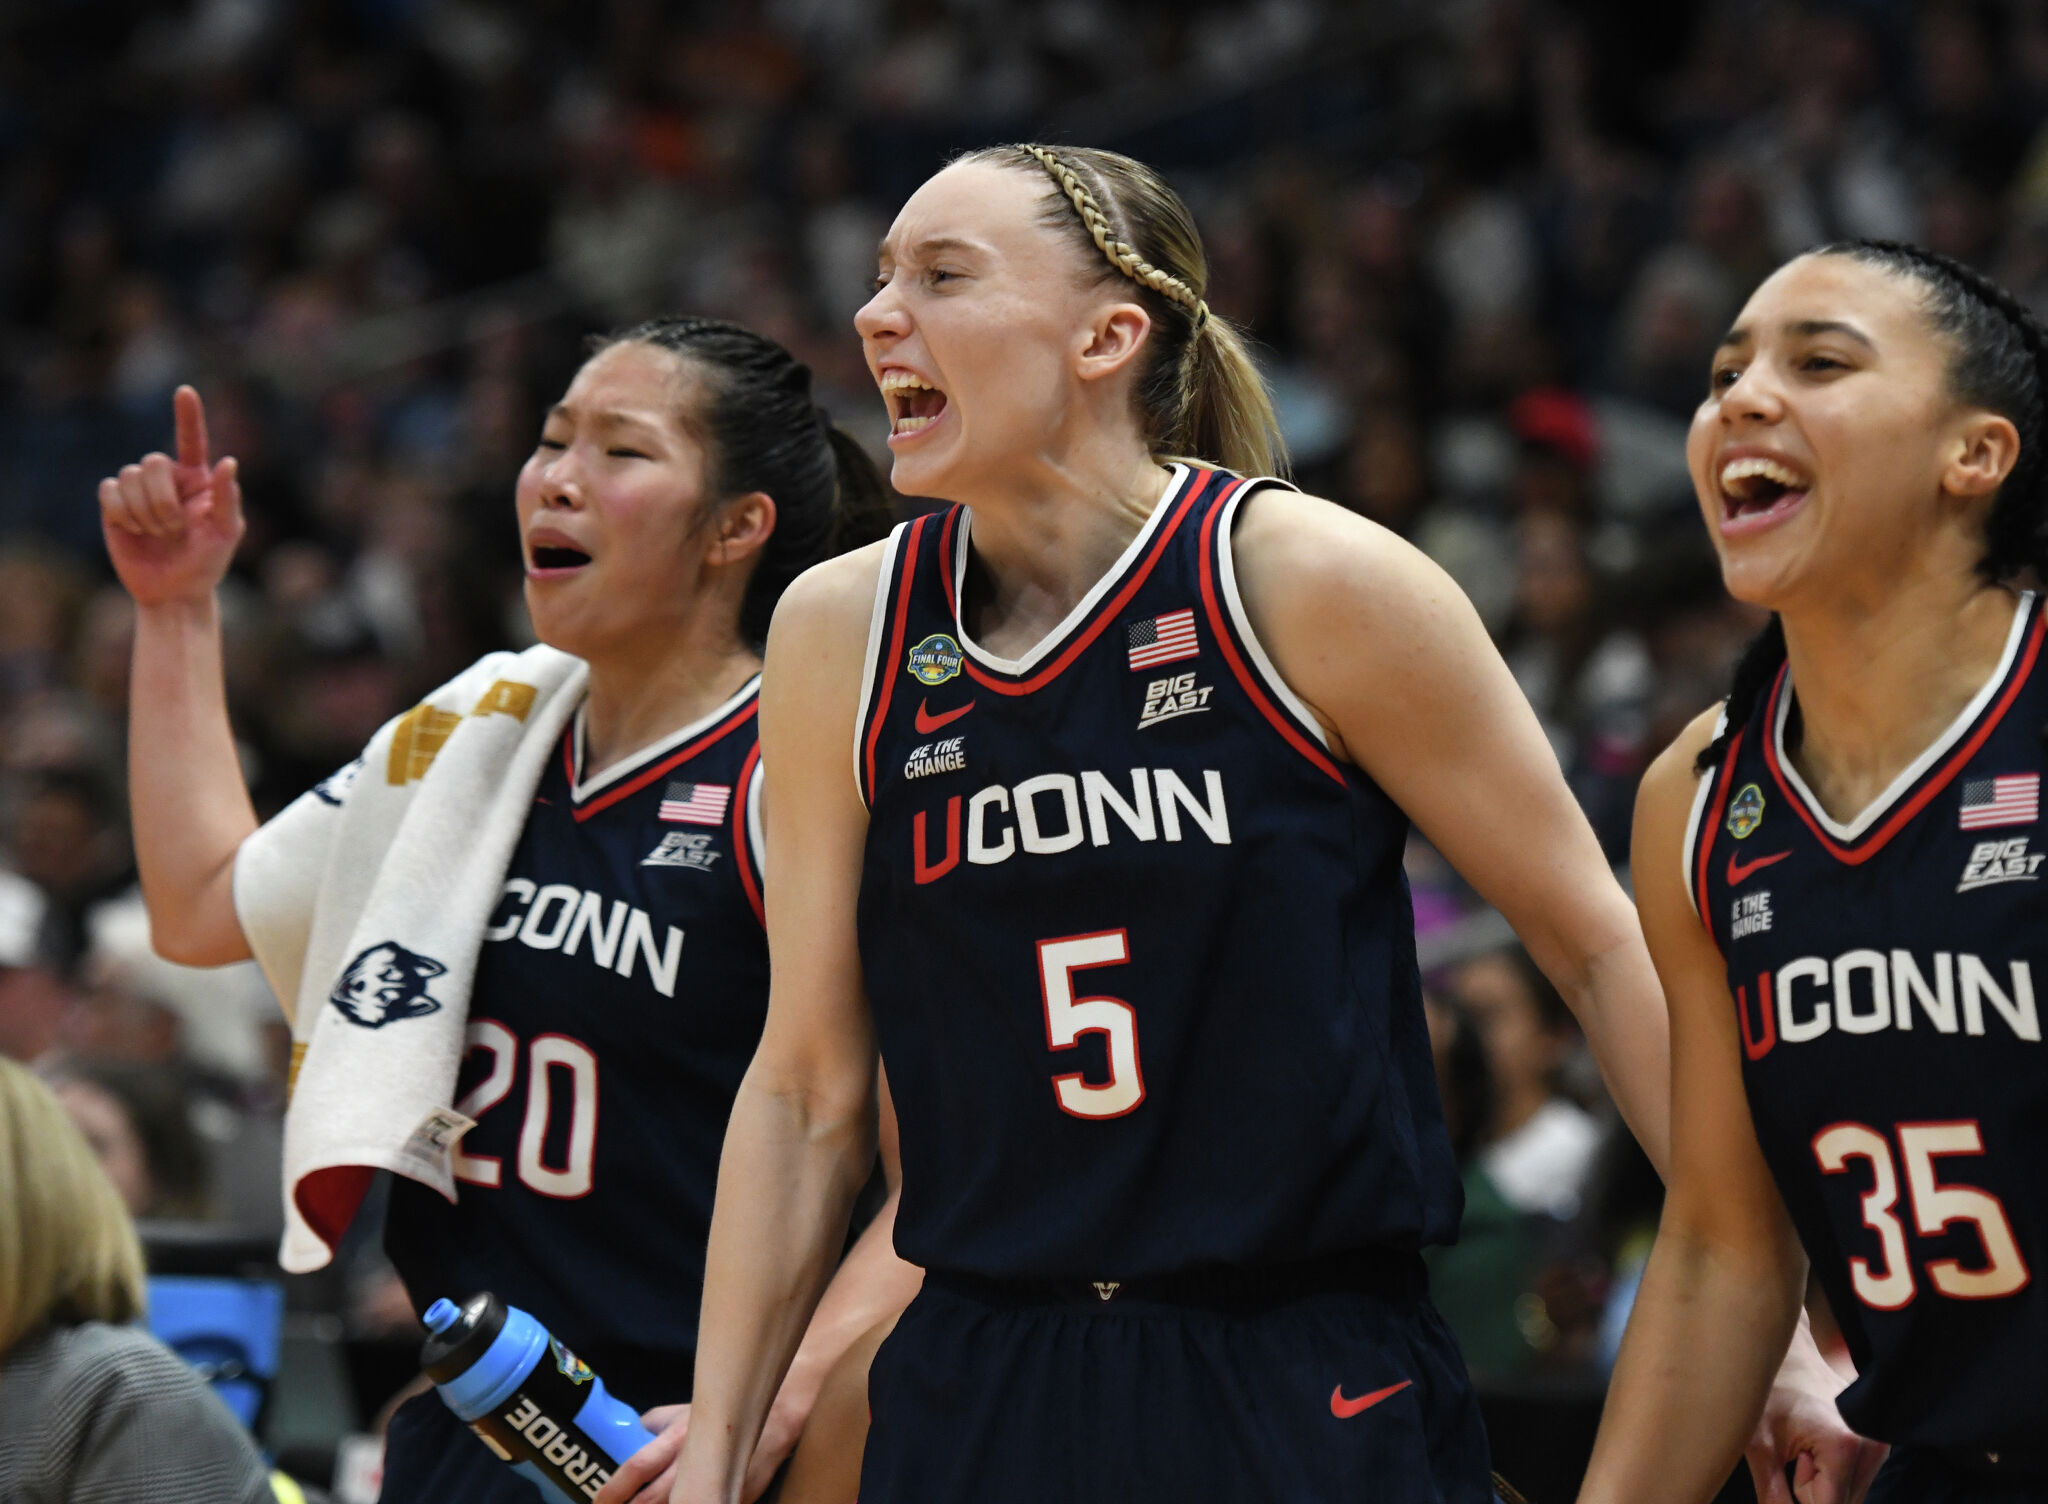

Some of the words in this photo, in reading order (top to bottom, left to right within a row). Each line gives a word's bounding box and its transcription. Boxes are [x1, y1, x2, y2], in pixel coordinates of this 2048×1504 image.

[912, 653, 936, 665] FINAL
[936, 654, 959, 669] FOUR
[1145, 671, 1197, 702] BIG
[1140, 686, 1214, 719] EAST
[909, 743, 934, 761] BE
[933, 736, 965, 756] THE
[904, 751, 967, 780] CHANGE
[659, 830, 713, 849] BIG
[913, 766, 1232, 885] UCONN
[647, 845, 722, 866] EAST
[1969, 837, 2031, 863] BIG
[1961, 853, 2047, 883] EAST
[1732, 900, 1741, 921] E
[1741, 892, 1771, 915] THE
[483, 877, 685, 999] CONN
[1737, 948, 2042, 1061] UCONN
[1035, 927, 1147, 1120] 5
[453, 1016, 599, 1199] 20
[1810, 1118, 2032, 1311] 35
[504, 1398, 612, 1503] ERADE
